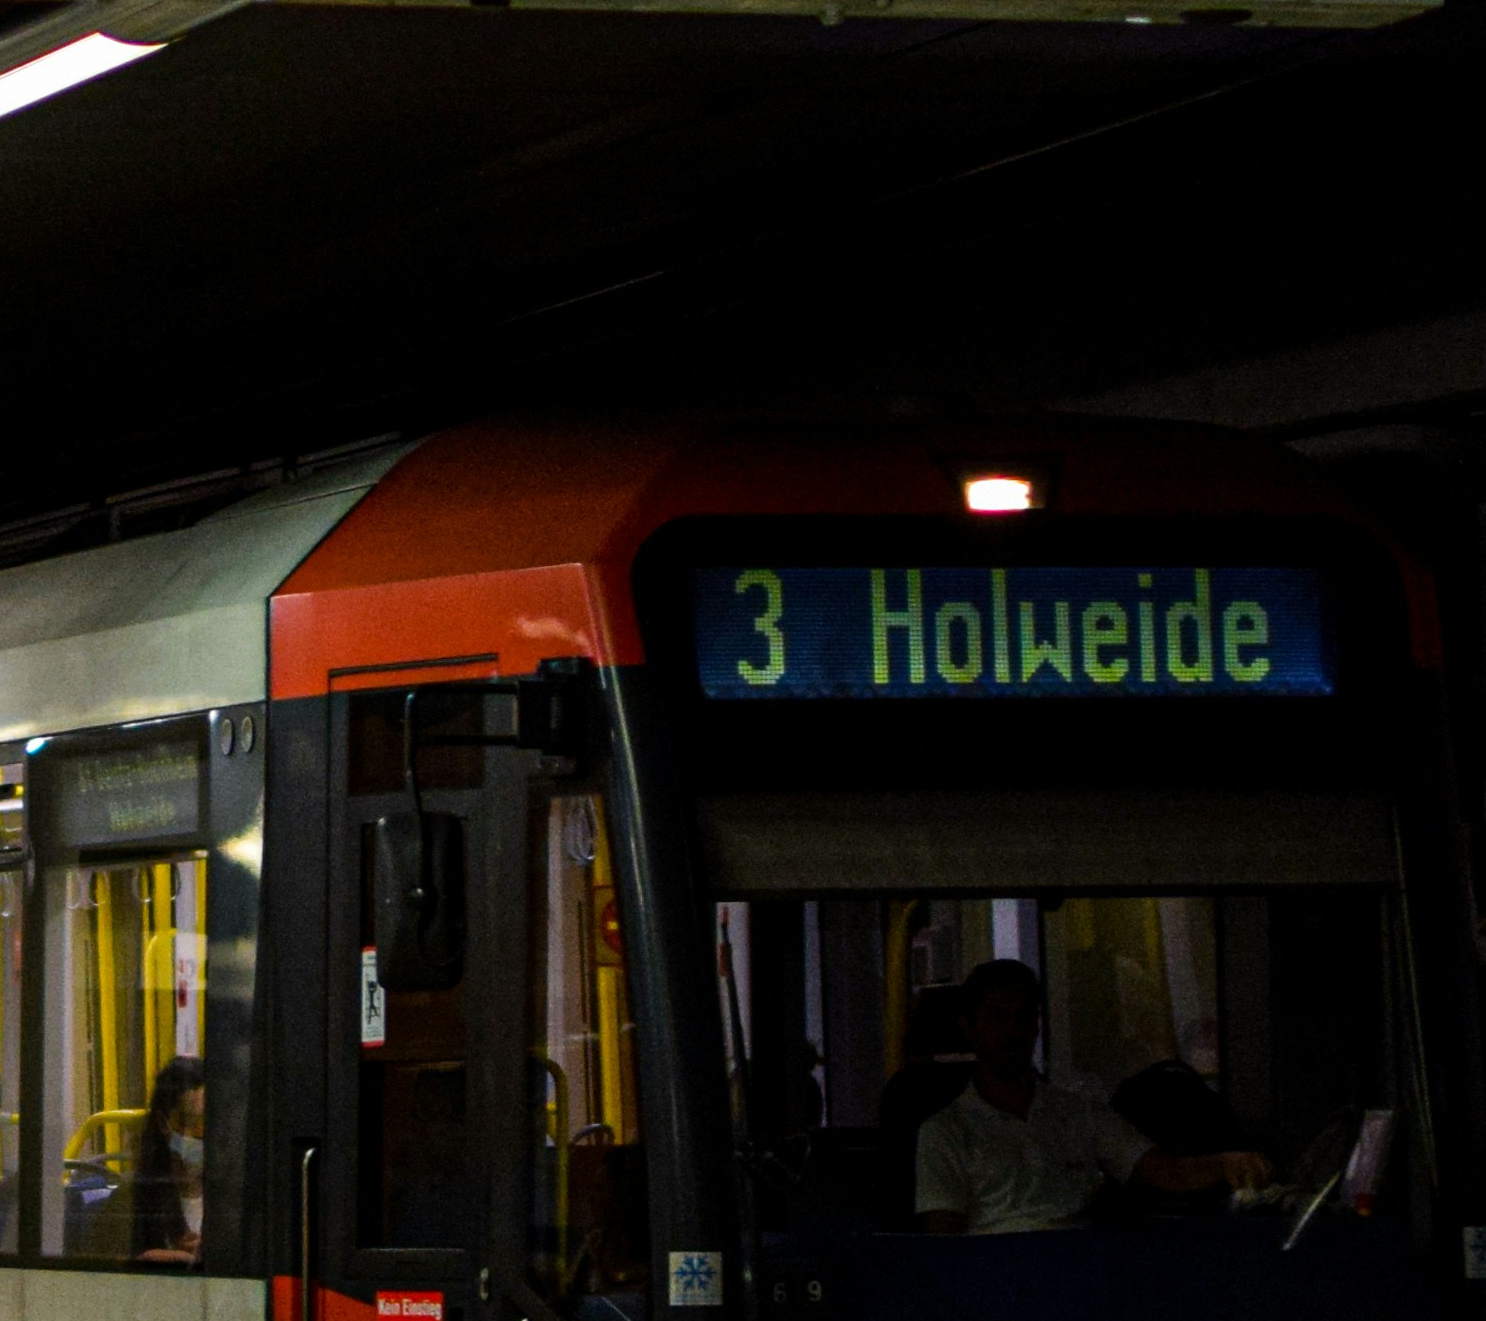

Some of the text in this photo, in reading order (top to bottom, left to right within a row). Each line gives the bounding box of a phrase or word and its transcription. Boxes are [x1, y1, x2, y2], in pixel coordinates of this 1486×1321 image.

[734, 568, 1273, 687] 3 Holweide
[378, 1299, 442, 1321] Kein Einstieg
